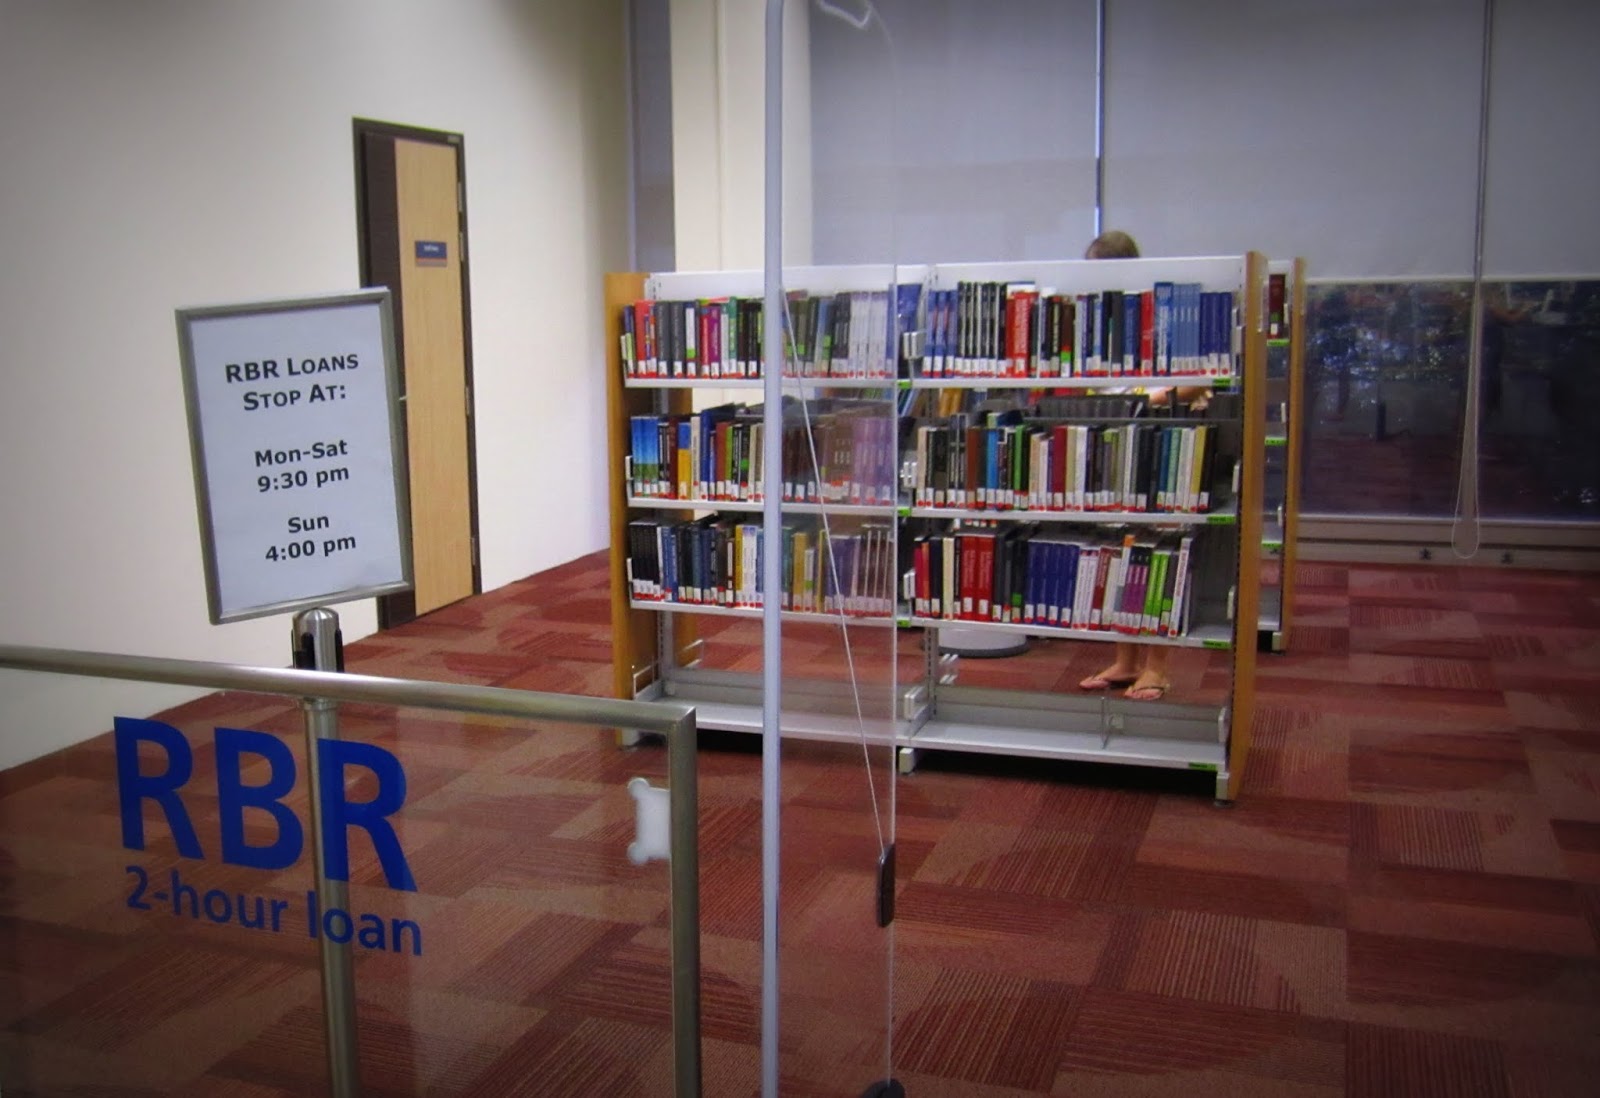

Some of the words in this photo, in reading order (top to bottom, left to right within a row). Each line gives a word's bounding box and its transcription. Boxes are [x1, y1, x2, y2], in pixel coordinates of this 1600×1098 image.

[225, 360, 280, 383] RBR
[255, 440, 348, 467] Mon-Sat
[257, 470, 308, 493] 9:30
[316, 467, 350, 488] pm
[288, 515, 330, 534] Sun
[265, 540, 315, 562] 4:00
[323, 535, 356, 557] pm
[113, 716, 418, 893] RBR
[125, 865, 289, 932] 2-hour
[307, 890, 422, 956] loan
